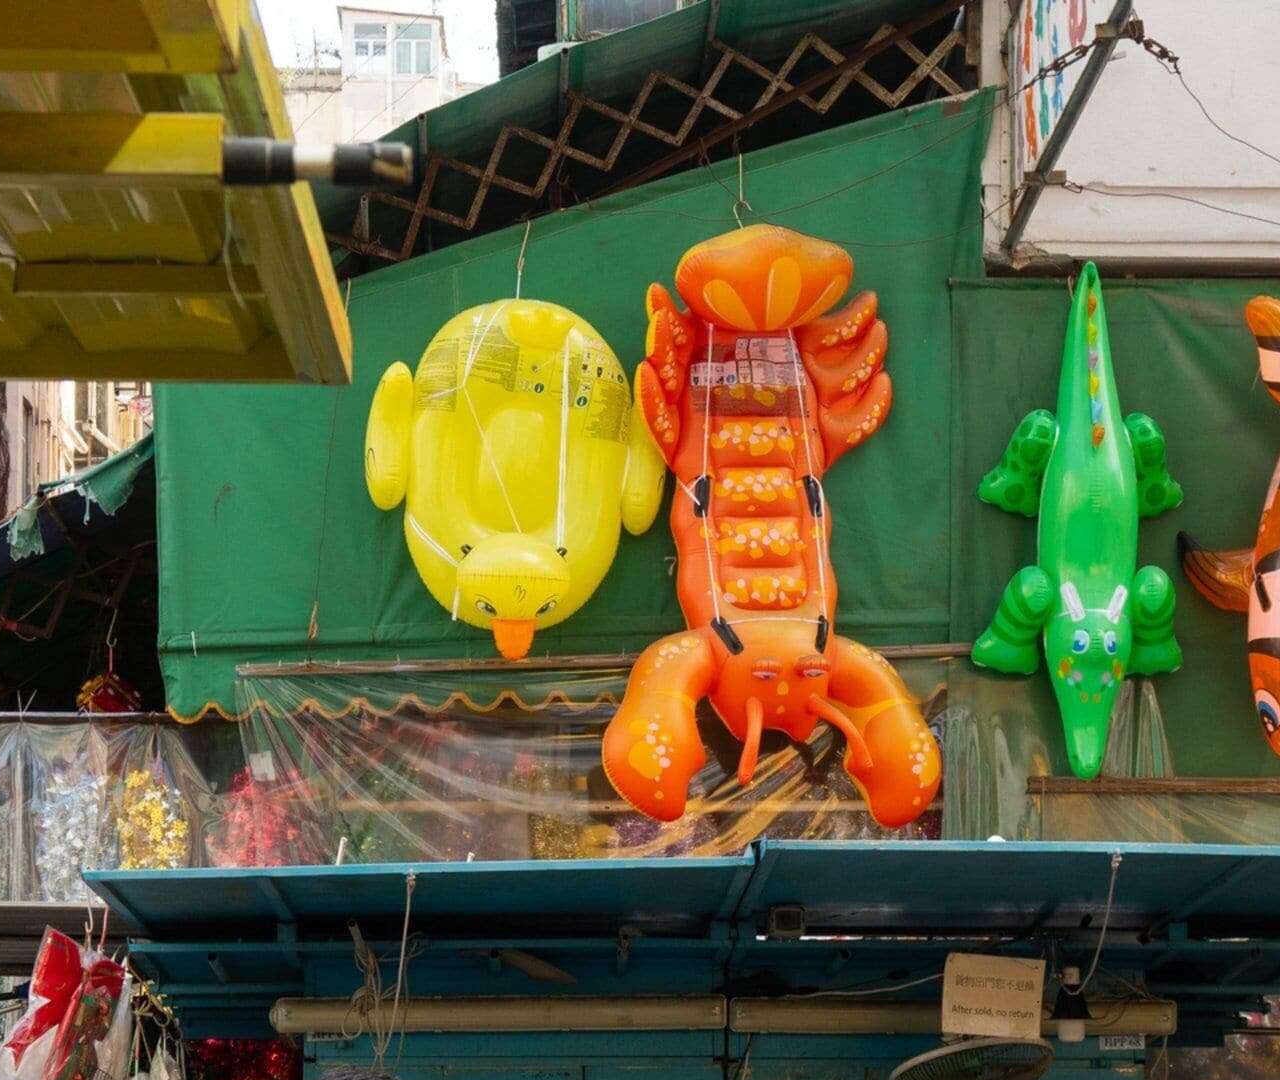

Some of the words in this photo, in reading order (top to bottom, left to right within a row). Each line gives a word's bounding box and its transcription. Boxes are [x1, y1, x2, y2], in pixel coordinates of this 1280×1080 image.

[952, 1004, 972, 1014] After
[996, 1009, 1007, 1017] no
[1009, 1009, 1034, 1019] return
